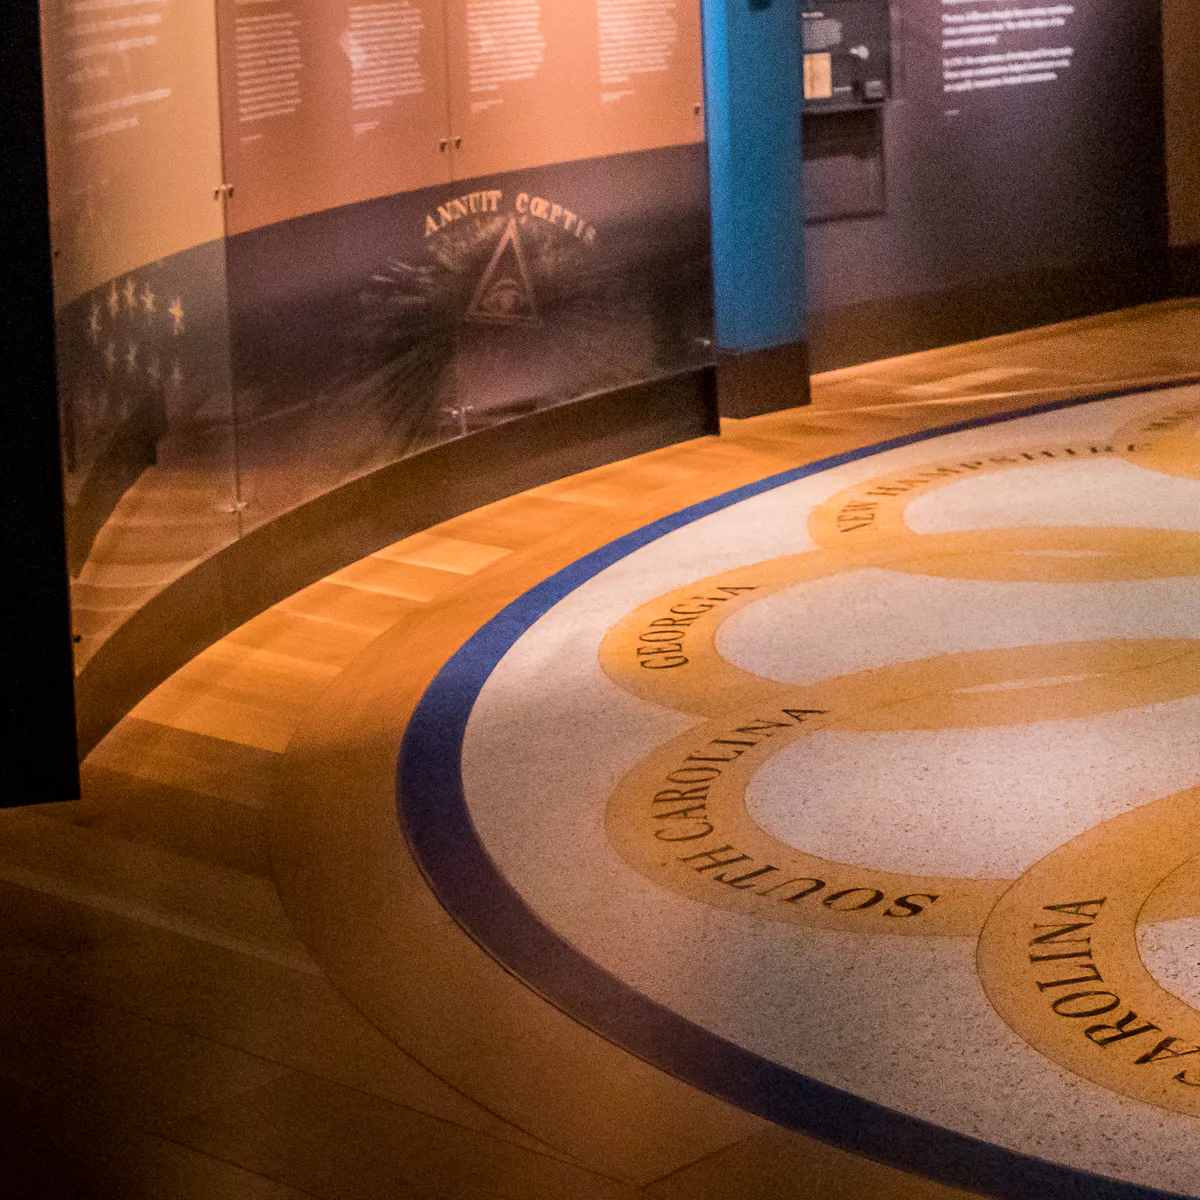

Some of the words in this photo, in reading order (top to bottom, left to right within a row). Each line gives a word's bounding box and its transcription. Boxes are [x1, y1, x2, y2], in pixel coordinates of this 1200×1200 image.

[636, 585, 759, 670] GEORGIA
[652, 708, 830, 842] CAROLINA
[677, 844, 940, 919] SOUTH
